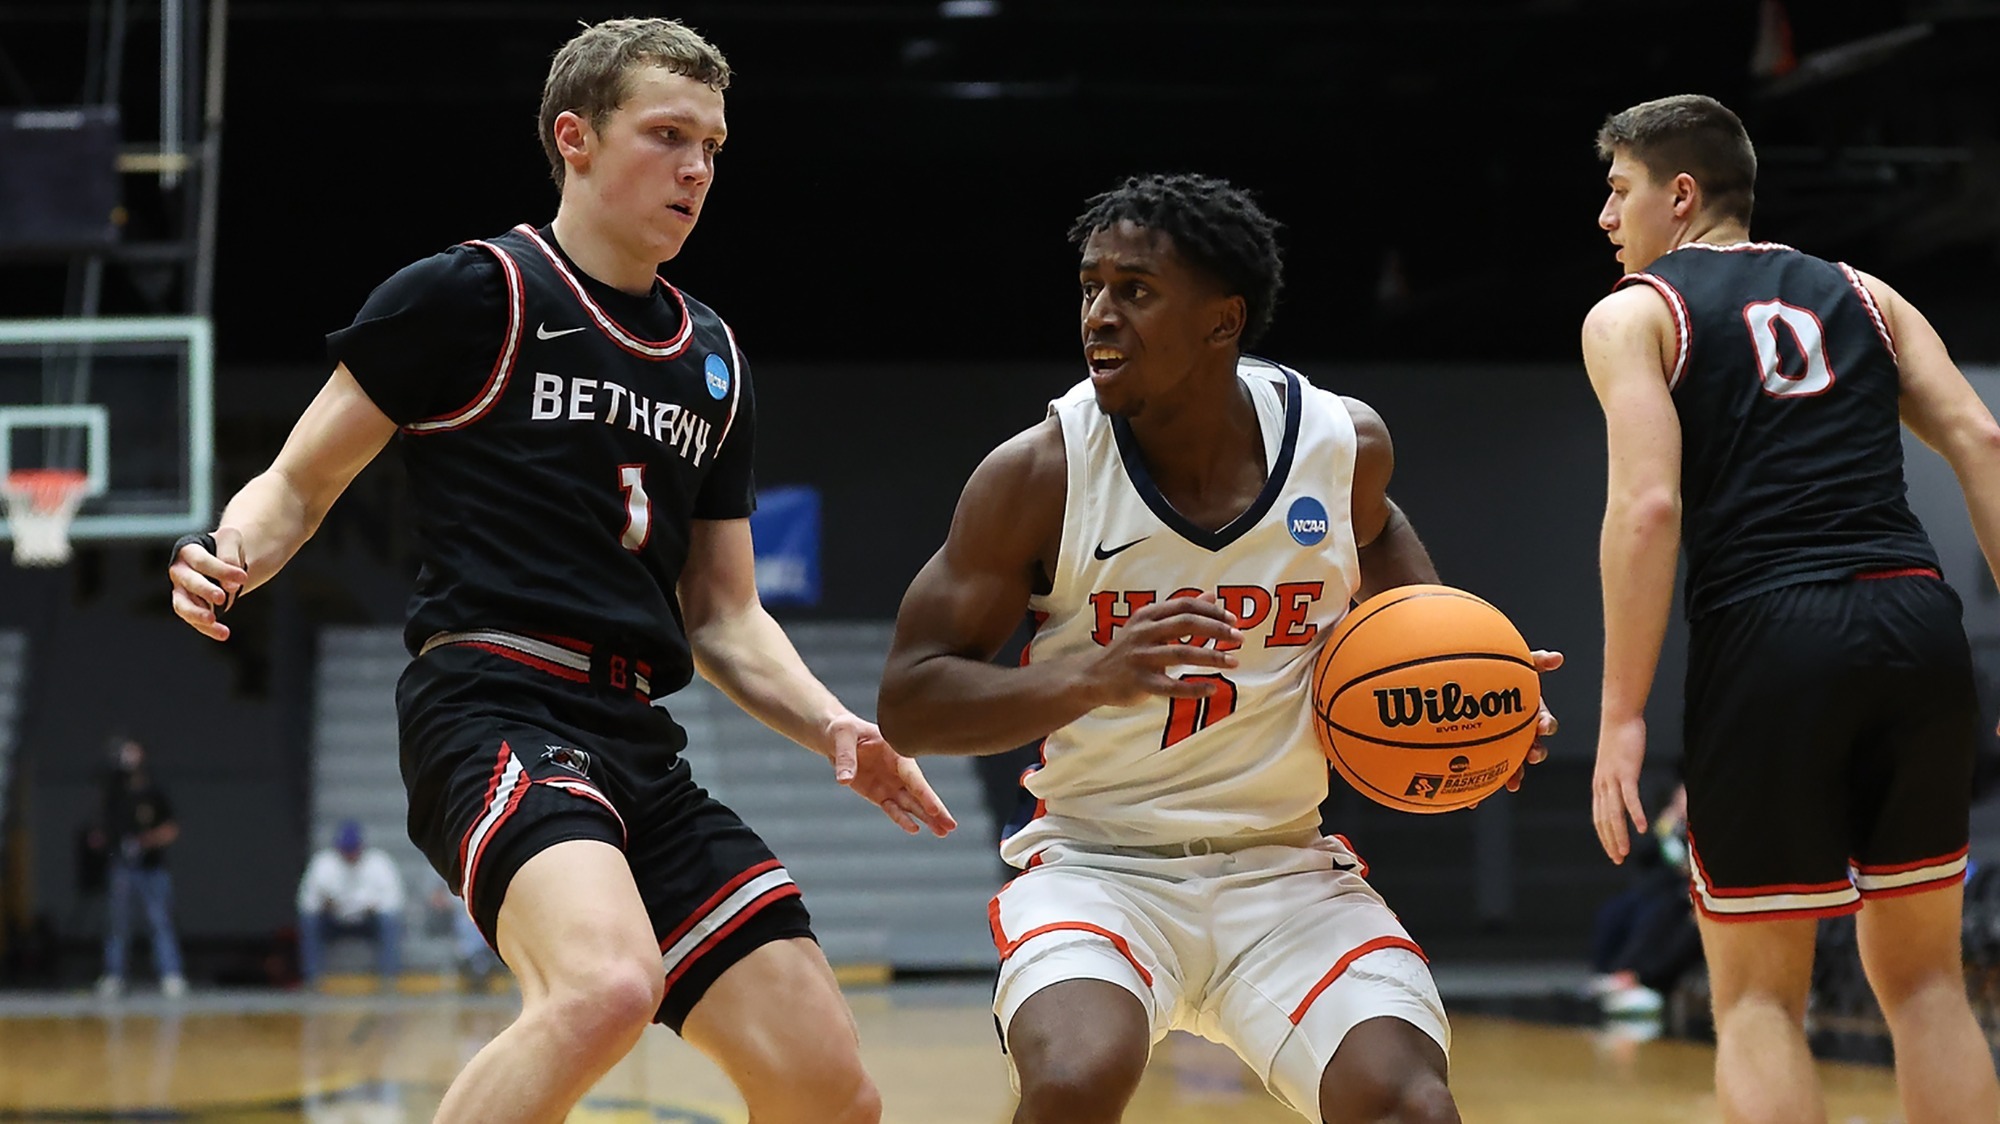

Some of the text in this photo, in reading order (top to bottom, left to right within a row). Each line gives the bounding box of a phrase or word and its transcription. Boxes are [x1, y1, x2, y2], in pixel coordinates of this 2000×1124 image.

[1743, 297, 1836, 399] 0
[531, 371, 712, 468] BETHANY
[617, 463, 651, 553] 1
[1292, 518, 1327, 534] NCAA
[1373, 682, 1523, 728] Wilson
[1436, 722, 1483, 733] EVO NXT
